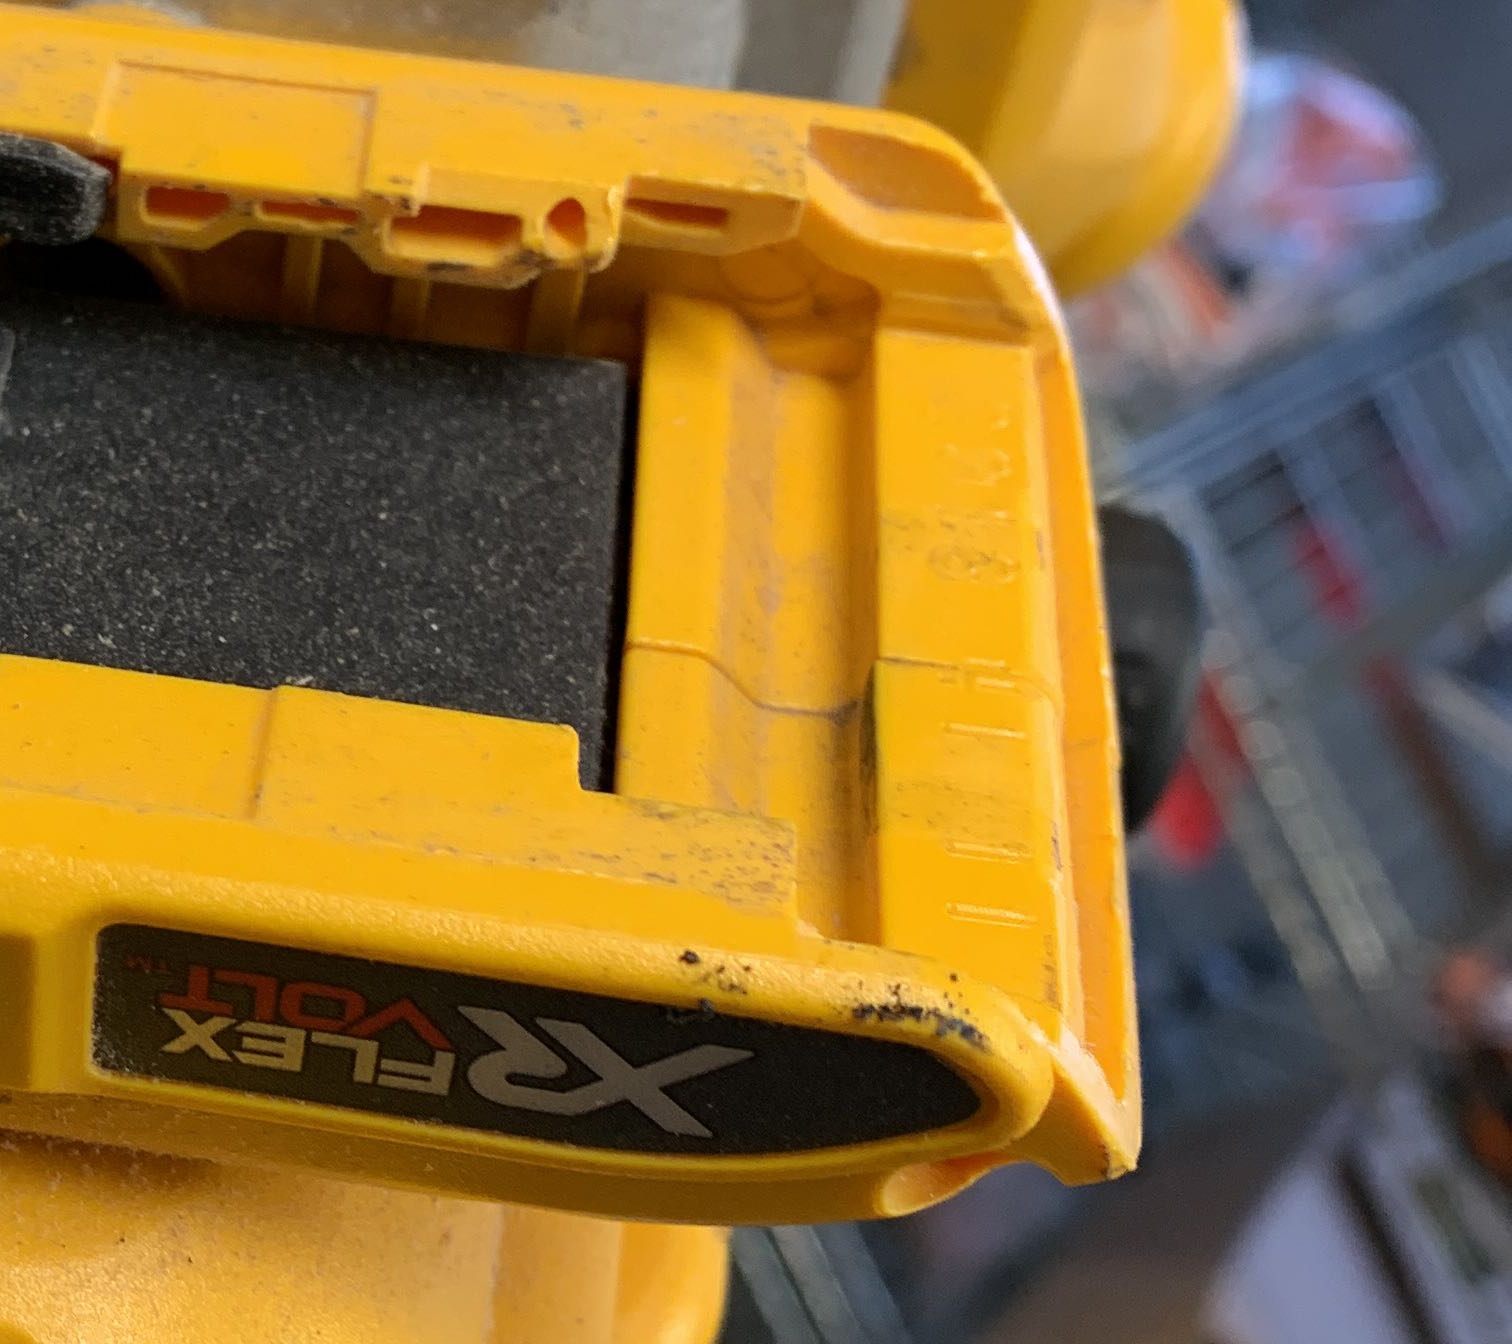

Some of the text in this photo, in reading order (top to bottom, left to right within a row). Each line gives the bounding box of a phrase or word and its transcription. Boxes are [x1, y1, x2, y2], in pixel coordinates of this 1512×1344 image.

[158, 965, 453, 1050] VOLT
[160, 1007, 455, 1096] FLEX
[457, 1006, 755, 1139] XR
